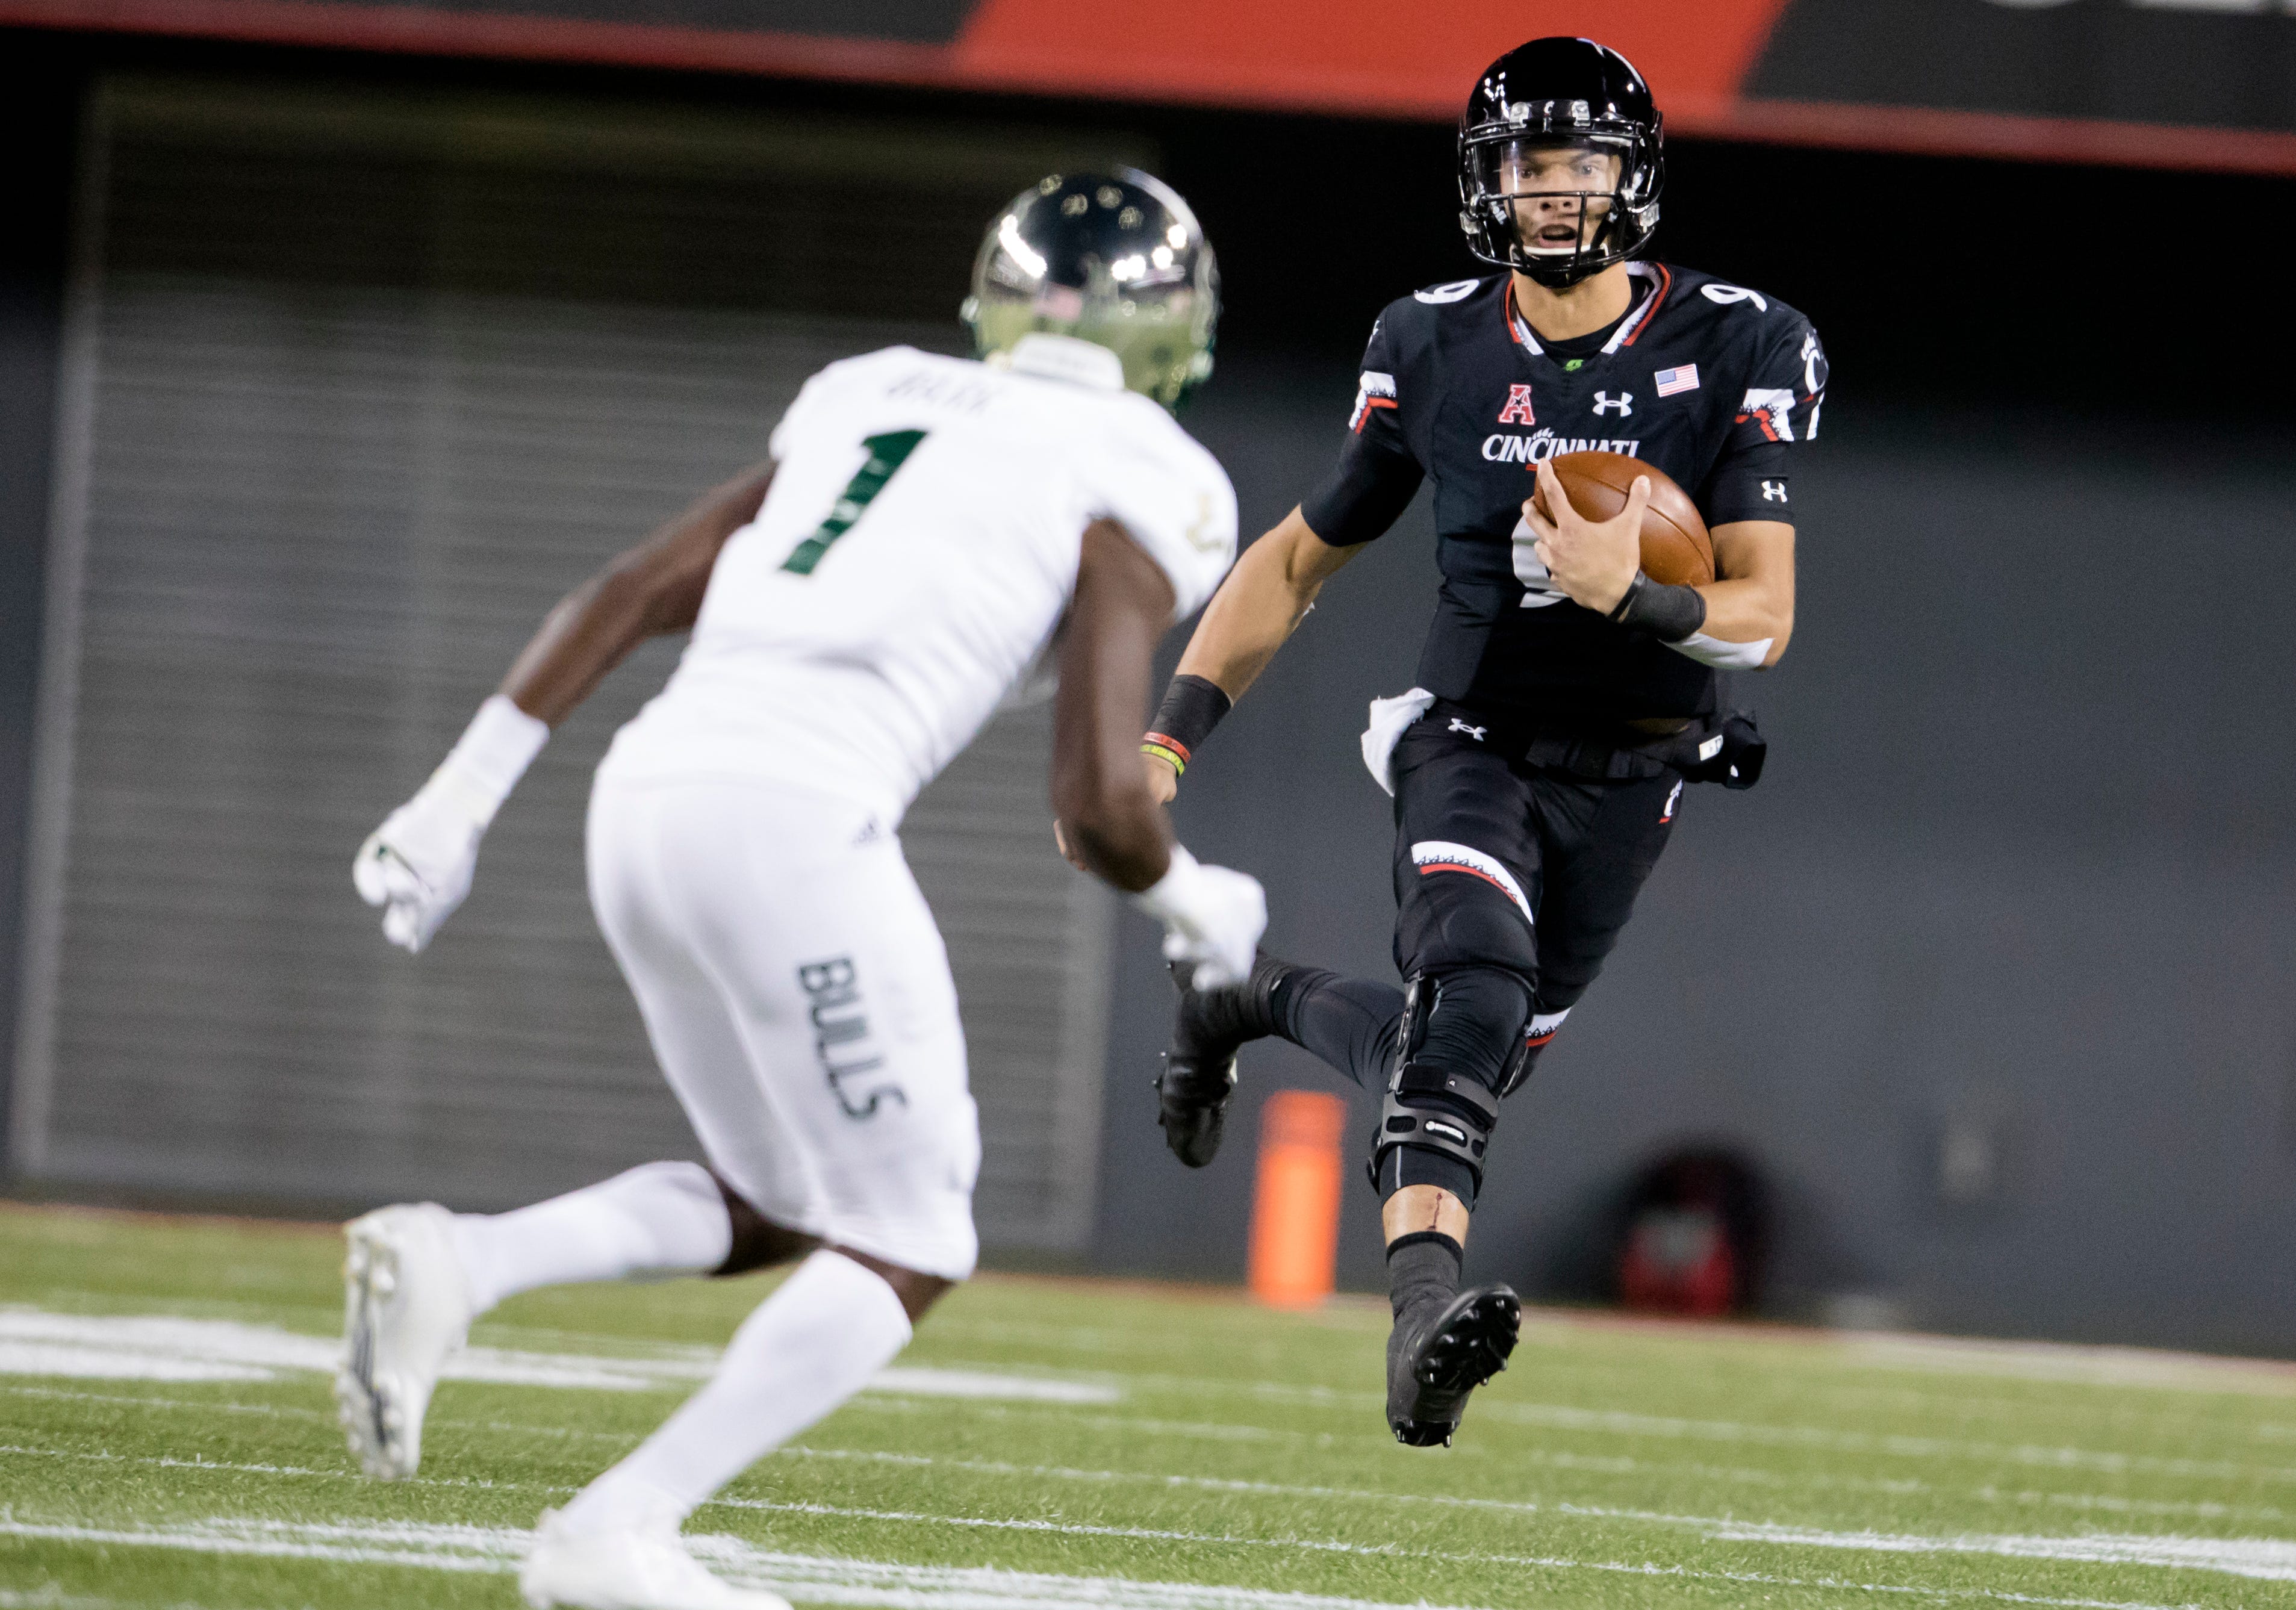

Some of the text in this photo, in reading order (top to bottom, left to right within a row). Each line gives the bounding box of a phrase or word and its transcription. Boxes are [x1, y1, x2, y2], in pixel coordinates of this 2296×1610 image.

[1700, 284, 1767, 312] 9
[1498, 384, 1535, 425] A
[779, 428, 929, 576] 1
[799, 957, 908, 1122] BULLS
